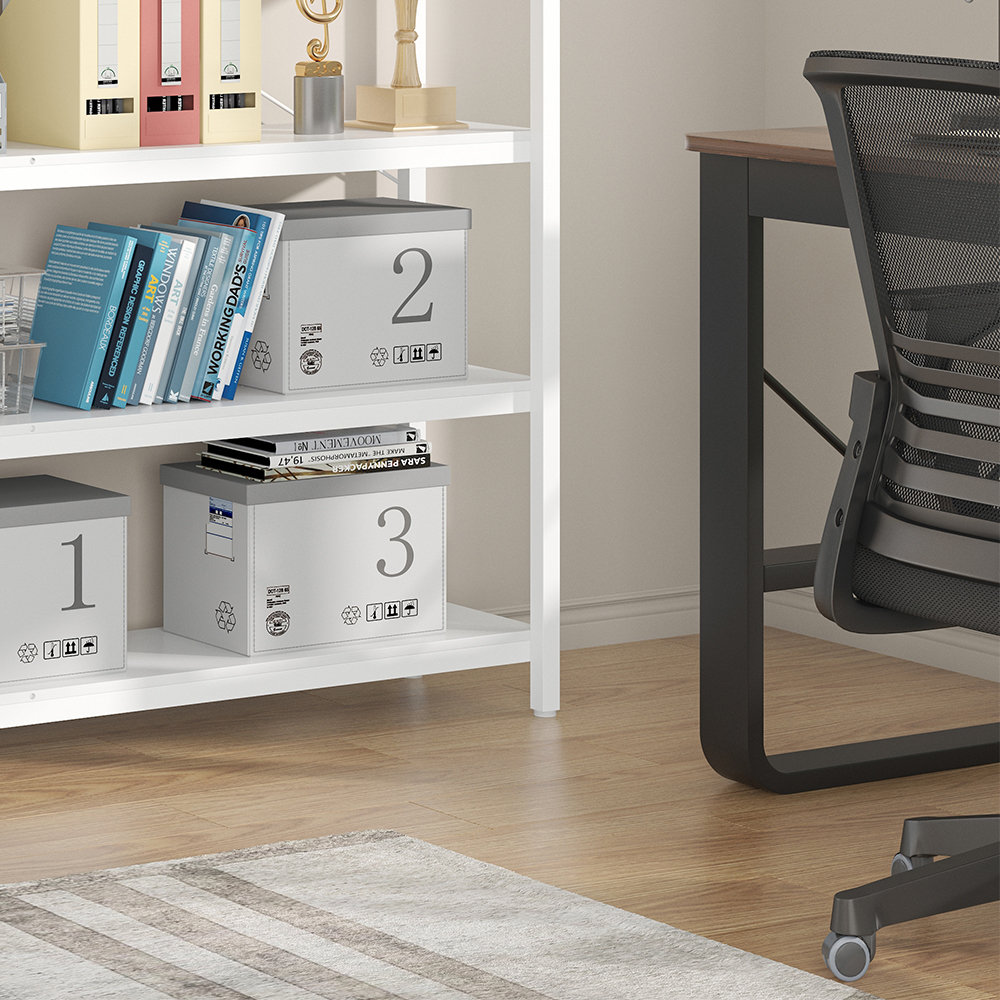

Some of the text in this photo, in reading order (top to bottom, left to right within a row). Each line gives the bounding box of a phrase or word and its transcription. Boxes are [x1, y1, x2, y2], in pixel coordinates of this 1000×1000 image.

[130, 260, 146, 295] GRAPHIC
[144, 274, 158, 304] ART
[151, 247, 179, 314] WINDOWS
[200, 246, 219, 297] TEXTILE DESIGNERS
[392, 248, 434, 324] 2
[122, 296, 137, 324] DESIGN
[170, 279, 184, 306] ART
[98, 305, 117, 350] BORDEAUX
[193, 284, 218, 357] Gardens in France
[207, 307, 234, 375] WORKING
[226, 264, 246, 307] DAD'S
[108, 325, 129, 378] REFERENCED
[136, 347, 149, 376] GOODMAN
[241, 337, 250, 356] SUSAN
[314, 434, 382, 449] MOOVEMENT
[386, 448, 406, 456] MAKE
[332, 457, 426, 472] SARA PENNYPACKER
[376, 506, 414, 578] 3
[61, 534, 96, 611] 1
